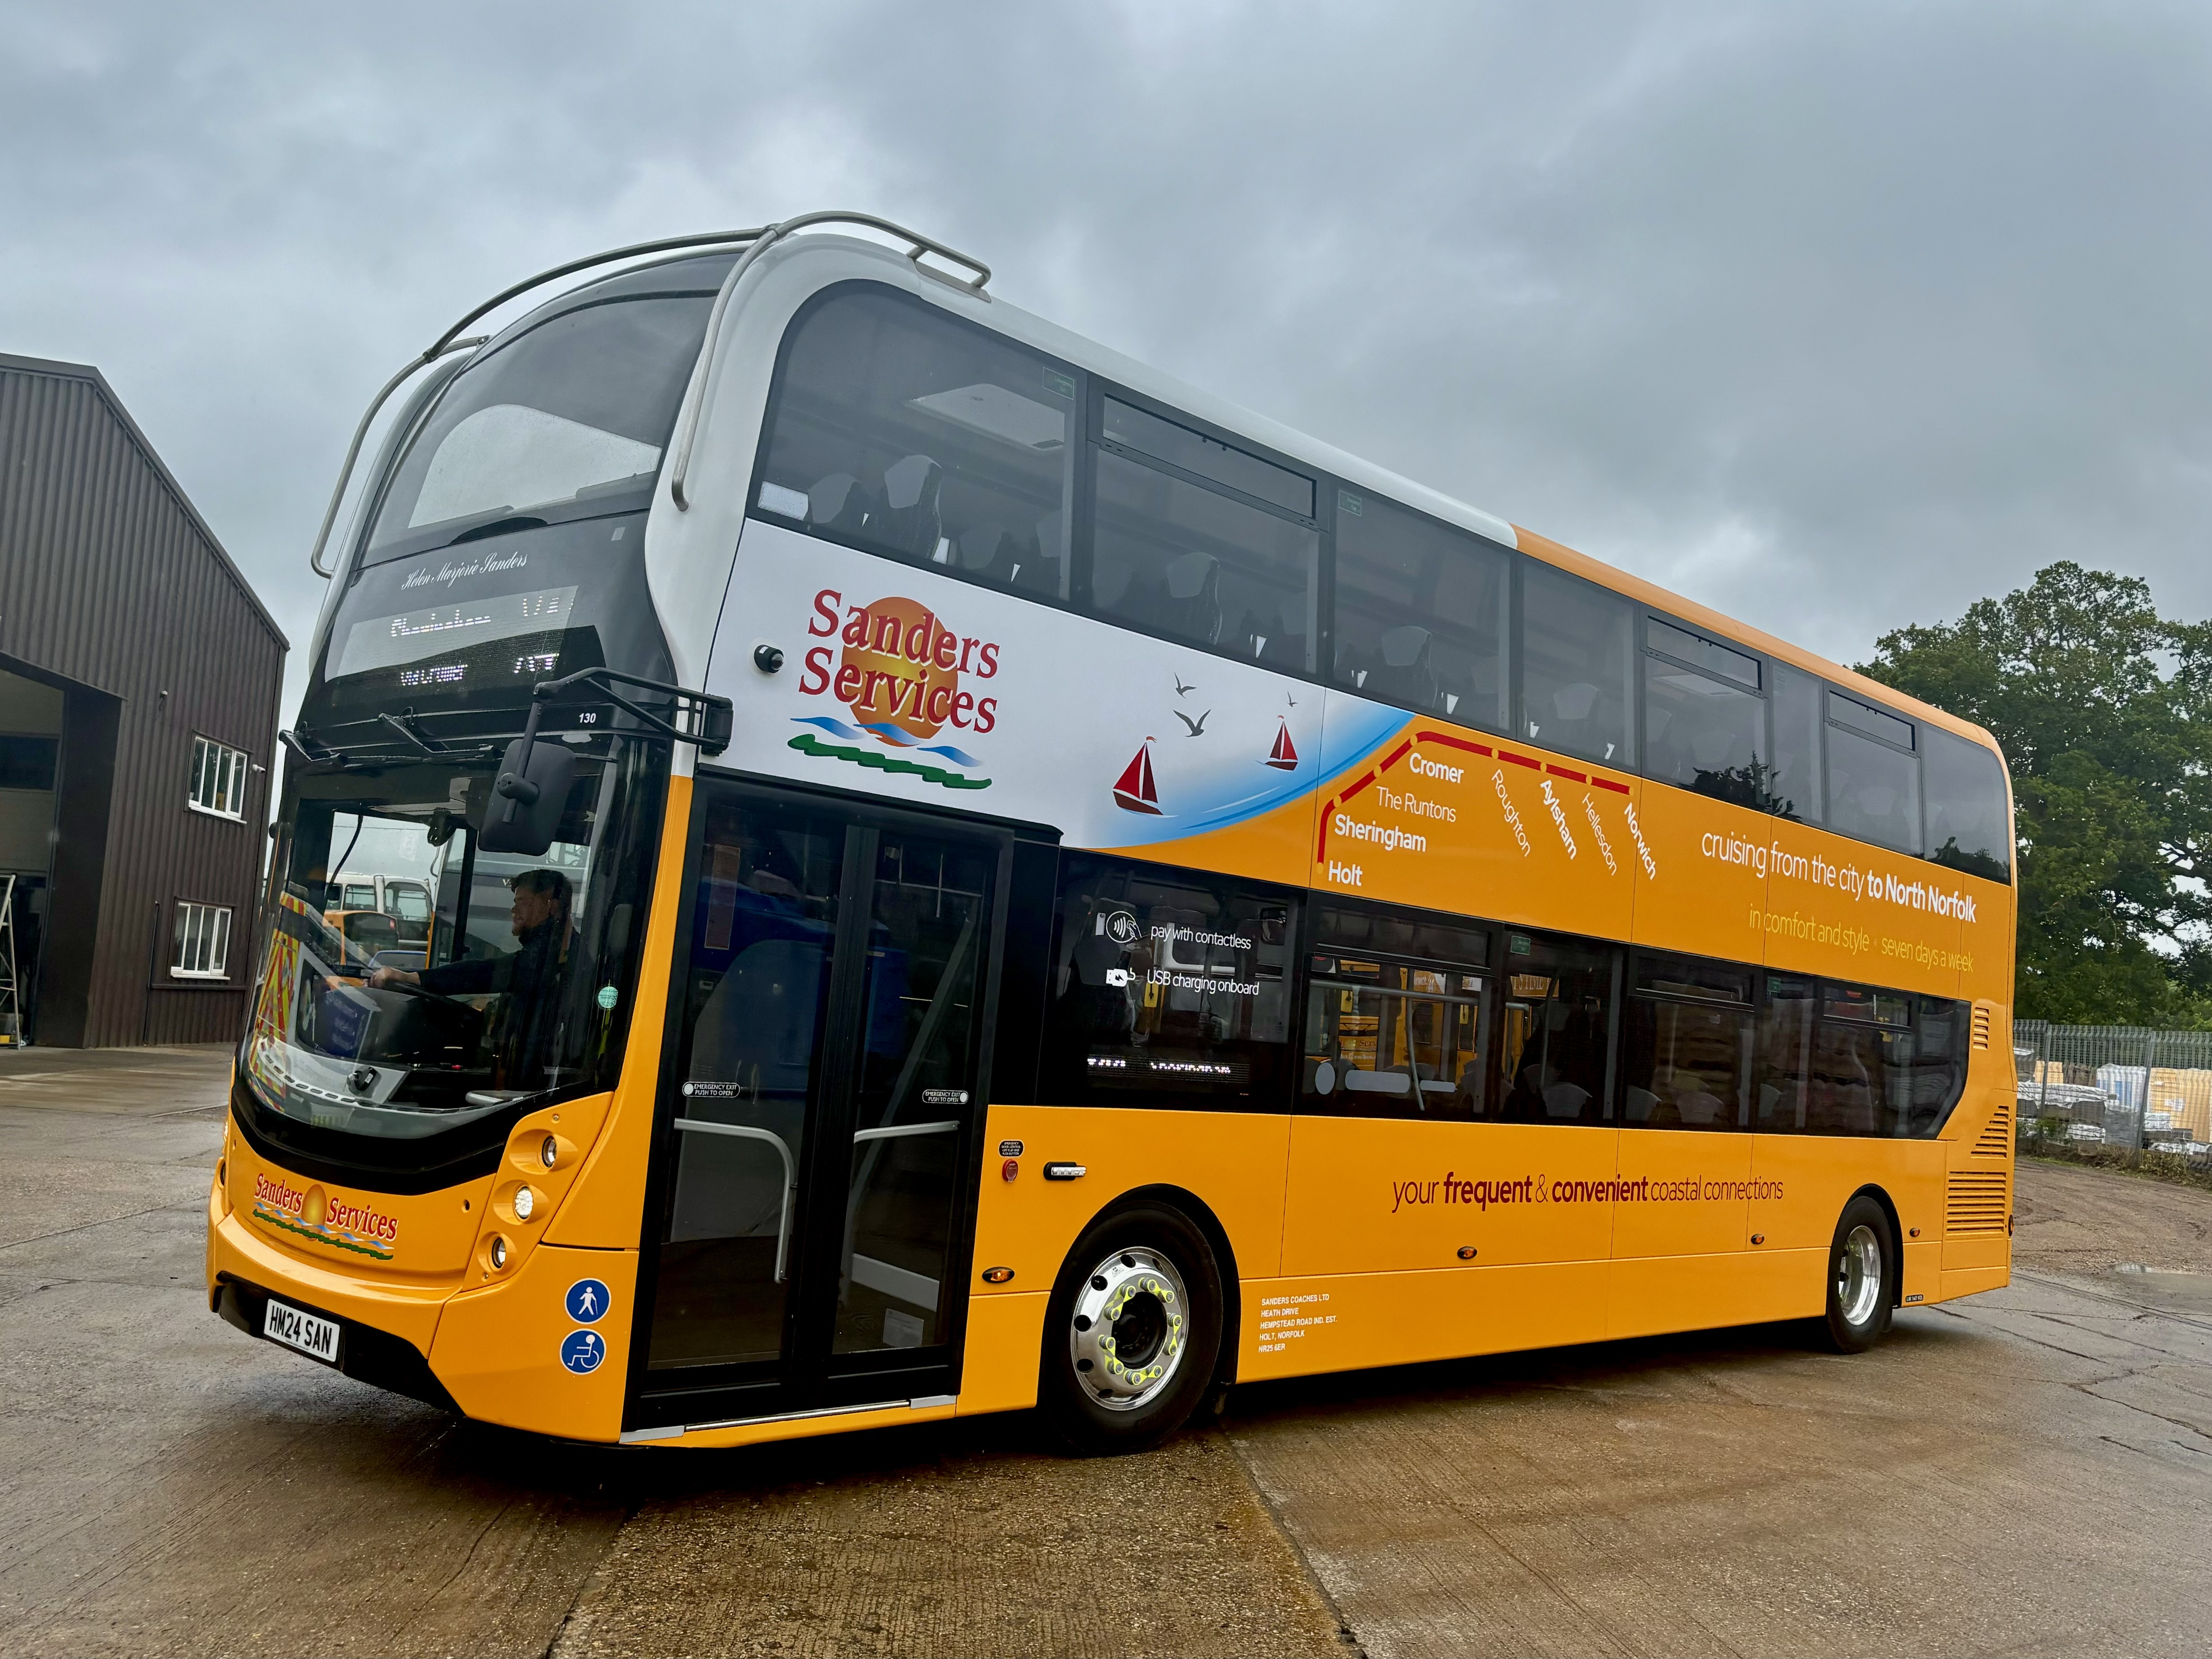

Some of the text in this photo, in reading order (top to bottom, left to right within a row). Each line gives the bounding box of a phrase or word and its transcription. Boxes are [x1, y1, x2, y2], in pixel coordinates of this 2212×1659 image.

[401, 552, 528, 590] Helen Marjorie Sanders
[808, 589, 1000, 678] Sanders
[799, 647, 997, 734] Services
[579, 713, 596, 723] 130
[1410, 752, 1464, 784] Cromer
[1376, 786, 1457, 823] The Runtons
[1491, 769, 1531, 857] Roughton
[1540, 779, 1577, 860] Aylsham
[1335, 814, 1426, 852] Sheringham
[1582, 792, 1618, 876] Hellesdon
[1623, 802, 1656, 880] Norwich
[1328, 860, 1362, 887] Holt
[1702, 832, 1977, 923] cruising from the city to North Norfolk
[1151, 925, 1252, 950] pay with contactless
[1749, 903, 1974, 973] in comfort and style seven days a week
[1147, 969, 1259, 996] USB charging onboard
[254, 1173, 399, 1242] Sanders Services
[1392, 1171, 1784, 1213] your frequent & convenient coastal connections
[1261, 1296, 1289, 1306] SANDERS
[1290, 1294, 1317, 1304] COACHES
[1261, 1307, 1299, 1317] HEATH DRIVE
[304, 1320, 332, 1354] SAN
[1259, 1330, 1305, 1341] HOLT, NORFOLK
[1260, 1319, 1295, 1329] HEMPSTEAD
[1296, 1317, 1312, 1326] ROAD
[1258, 1343, 1285, 1353] NR25 6ER
